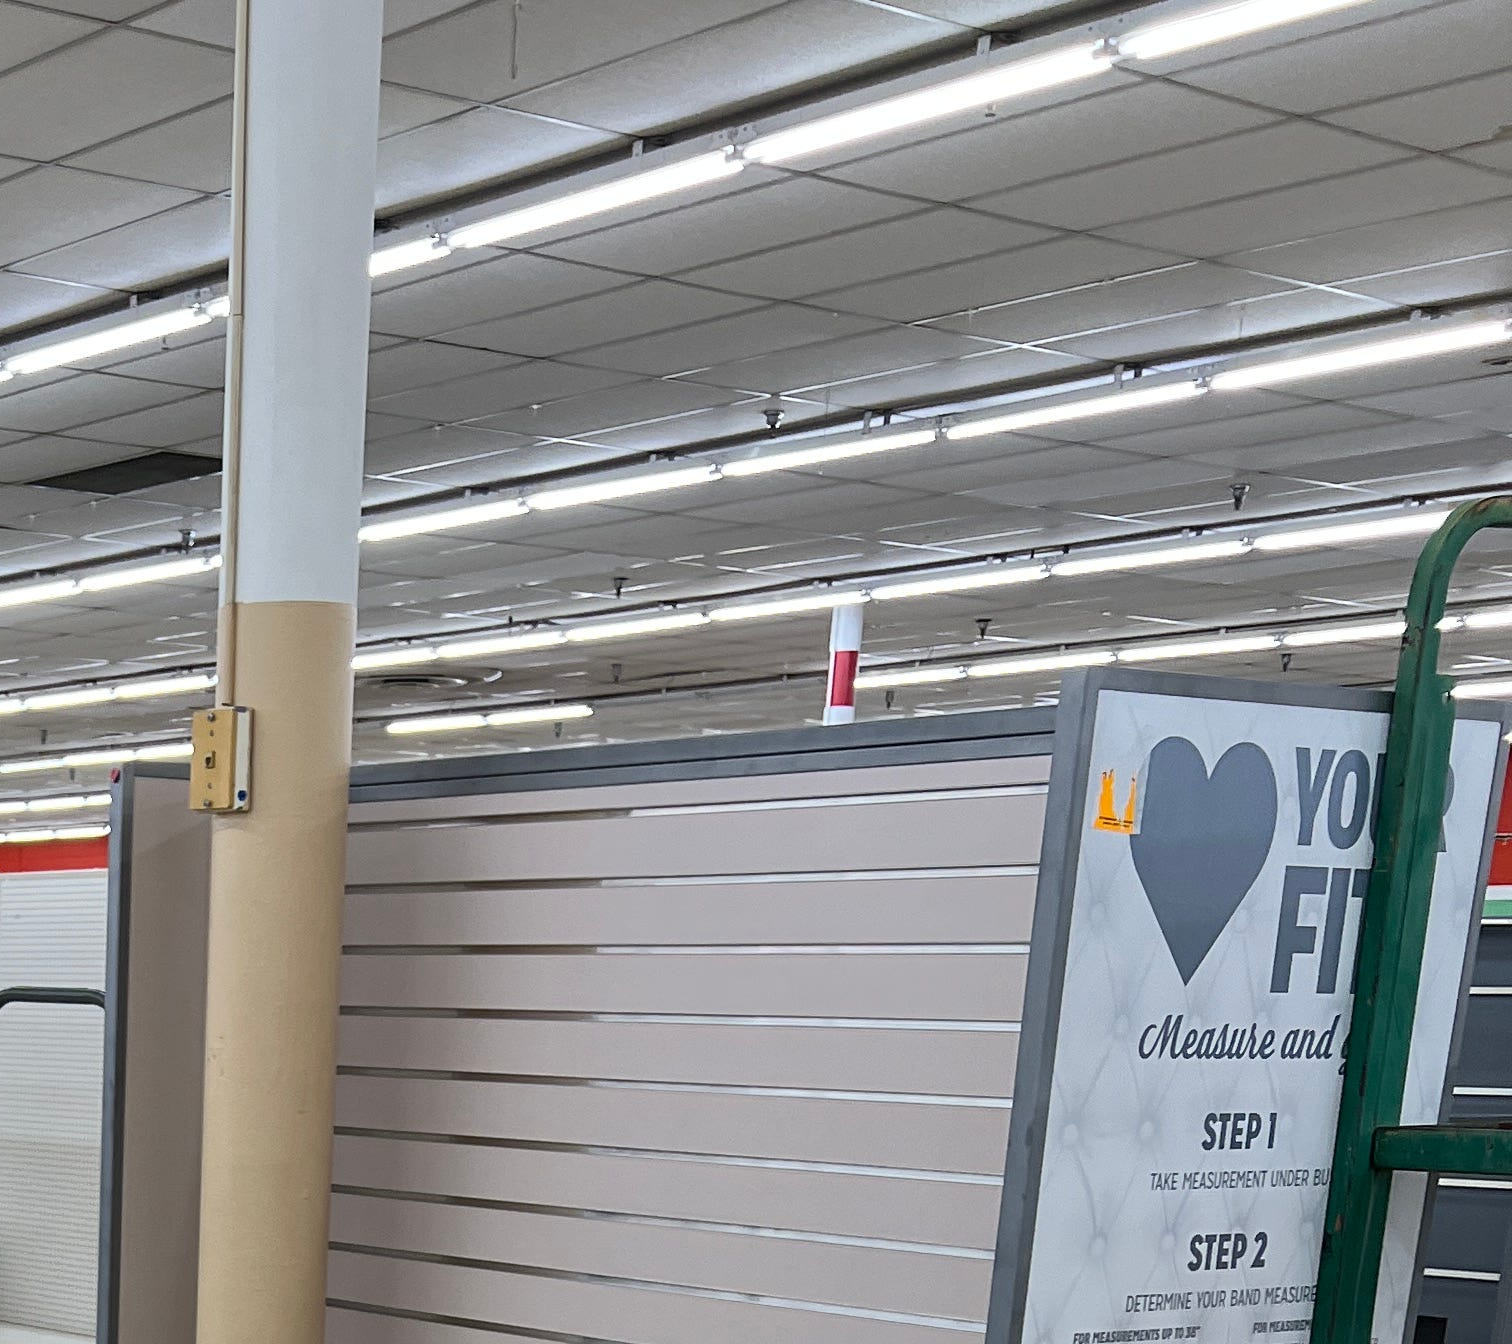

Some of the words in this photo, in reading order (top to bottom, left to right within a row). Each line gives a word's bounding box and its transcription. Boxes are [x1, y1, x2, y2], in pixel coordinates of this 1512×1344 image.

[1138, 1014, 1276, 1060] Measure
[1280, 1014, 1342, 1060] and
[1201, 1112, 1263, 1151] STEP
[1267, 1112, 1278, 1149] 1
[1150, 1172, 1180, 1191] TAKE
[1181, 1169, 1269, 1190] MEASUREMENT
[1270, 1168, 1310, 1188] UNDER
[1187, 1233, 1248, 1272] STEP
[1250, 1231, 1268, 1269] 2
[1125, 1291, 1193, 1313] DETERMINE
[1196, 1290, 1226, 1309] YOUR
[1230, 1288, 1261, 1307] BAND
[1073, 1332, 1090, 1344] FOR
[1092, 1328, 1160, 1344] MEASUREMENTS
[1162, 1327, 1173, 1340] UP
[1174, 1327, 1184, 1339] TO
